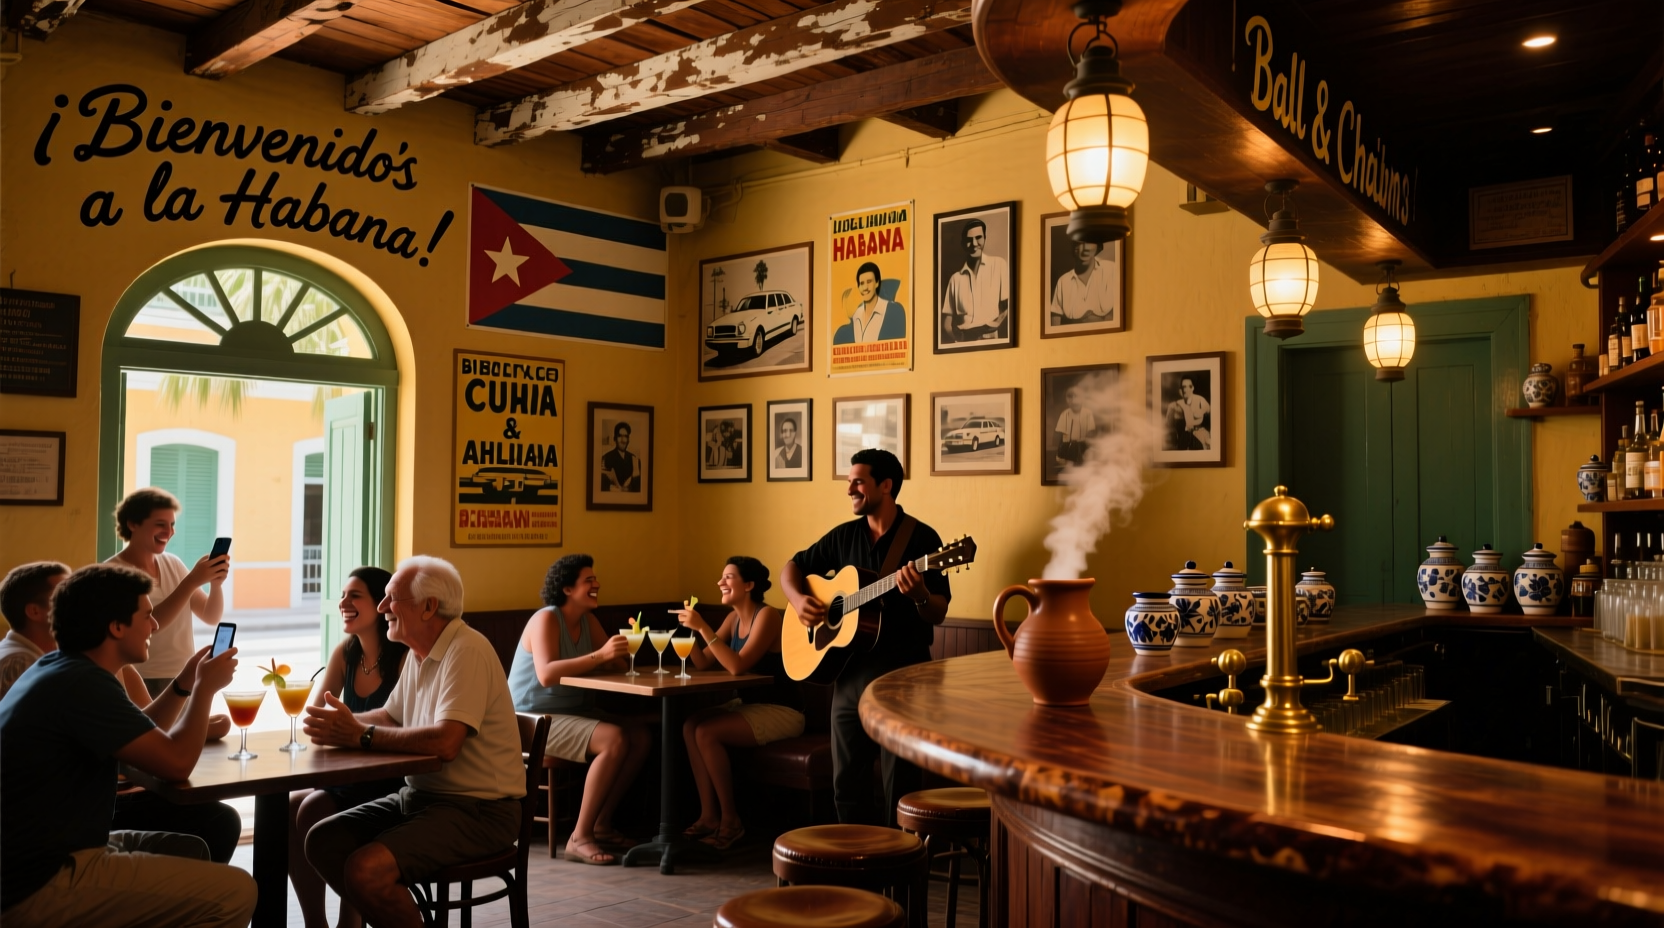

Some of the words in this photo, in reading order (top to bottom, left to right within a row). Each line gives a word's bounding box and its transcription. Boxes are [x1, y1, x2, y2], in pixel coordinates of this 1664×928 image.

[1245, 15, 1306, 140] Ball
[1312, 80, 1331, 165] &
[79, 190, 123, 227] a
[143, 161, 205, 222] la
[219, 168, 455, 267] Habana!
[833, 227, 905, 262] HABANA
[503, 417, 521, 439] &
